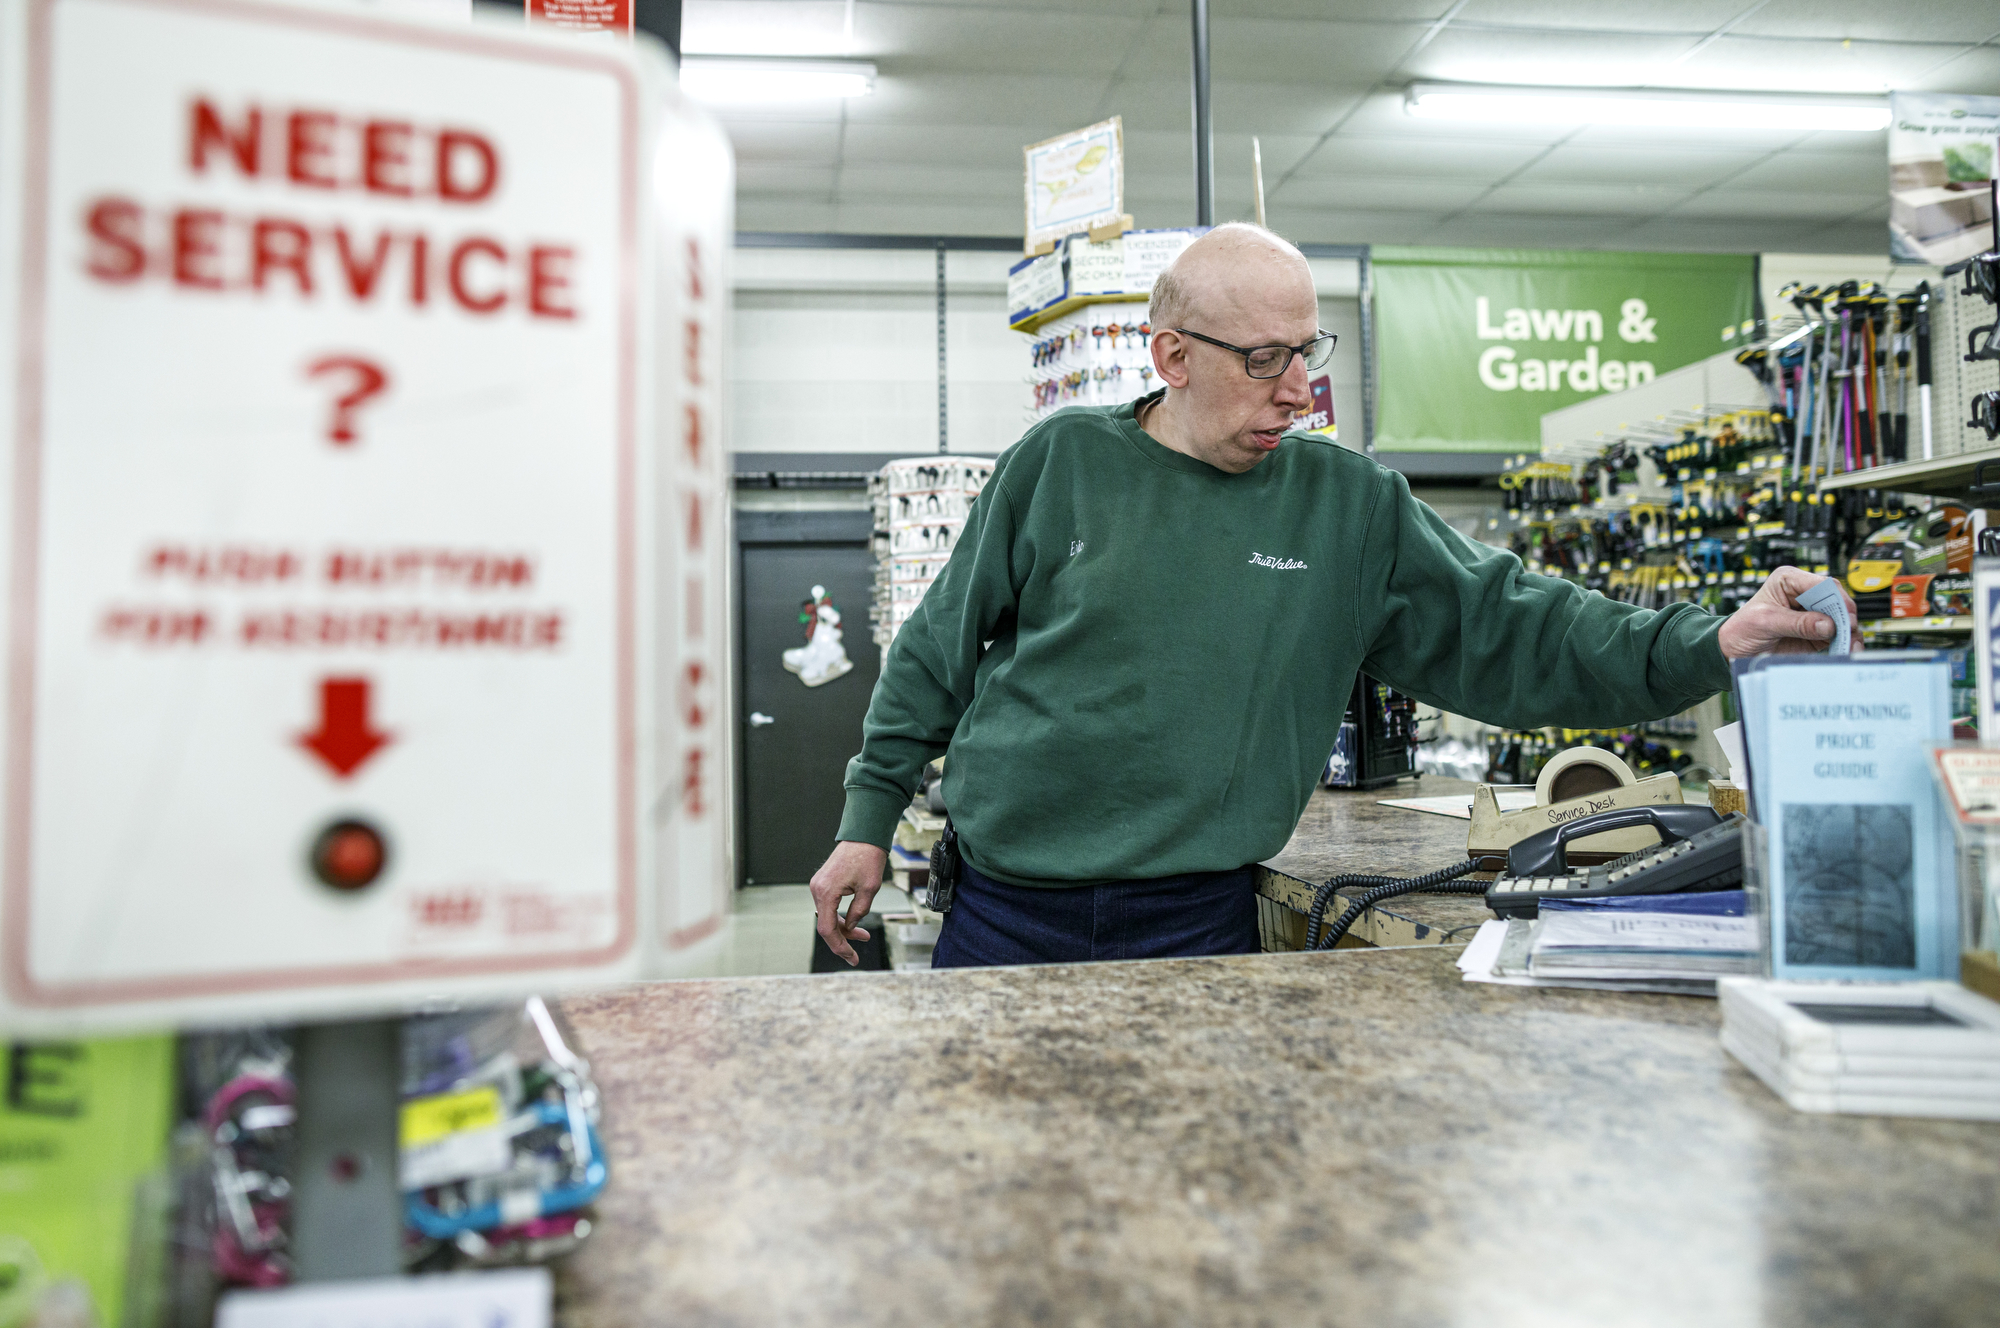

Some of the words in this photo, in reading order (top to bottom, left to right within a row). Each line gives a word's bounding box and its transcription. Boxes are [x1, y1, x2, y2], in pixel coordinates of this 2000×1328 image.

[187, 97, 500, 204] NEED
[84, 196, 580, 320] SERVICE
[1074, 254, 1124, 267] SECTION
[1476, 297, 1603, 342] Lawn
[1618, 298, 1658, 343] &
[1478, 346, 1656, 392] Garden
[302, 352, 390, 446] ?
[1946, 536, 1970, 550] Hose
[144, 542, 302, 584] PUSH
[322, 545, 538, 589] BUTTON
[98, 607, 212, 647] FOR
[240, 608, 566, 651] ASSISTANCE
[1778, 703, 1912, 721] SHARPENING
[1815, 733, 1875, 750] PRICE
[1813, 762, 1878, 780] GUIDE
[1548, 806, 1587, 824] Service
[1585, 795, 1616, 814] Desk
